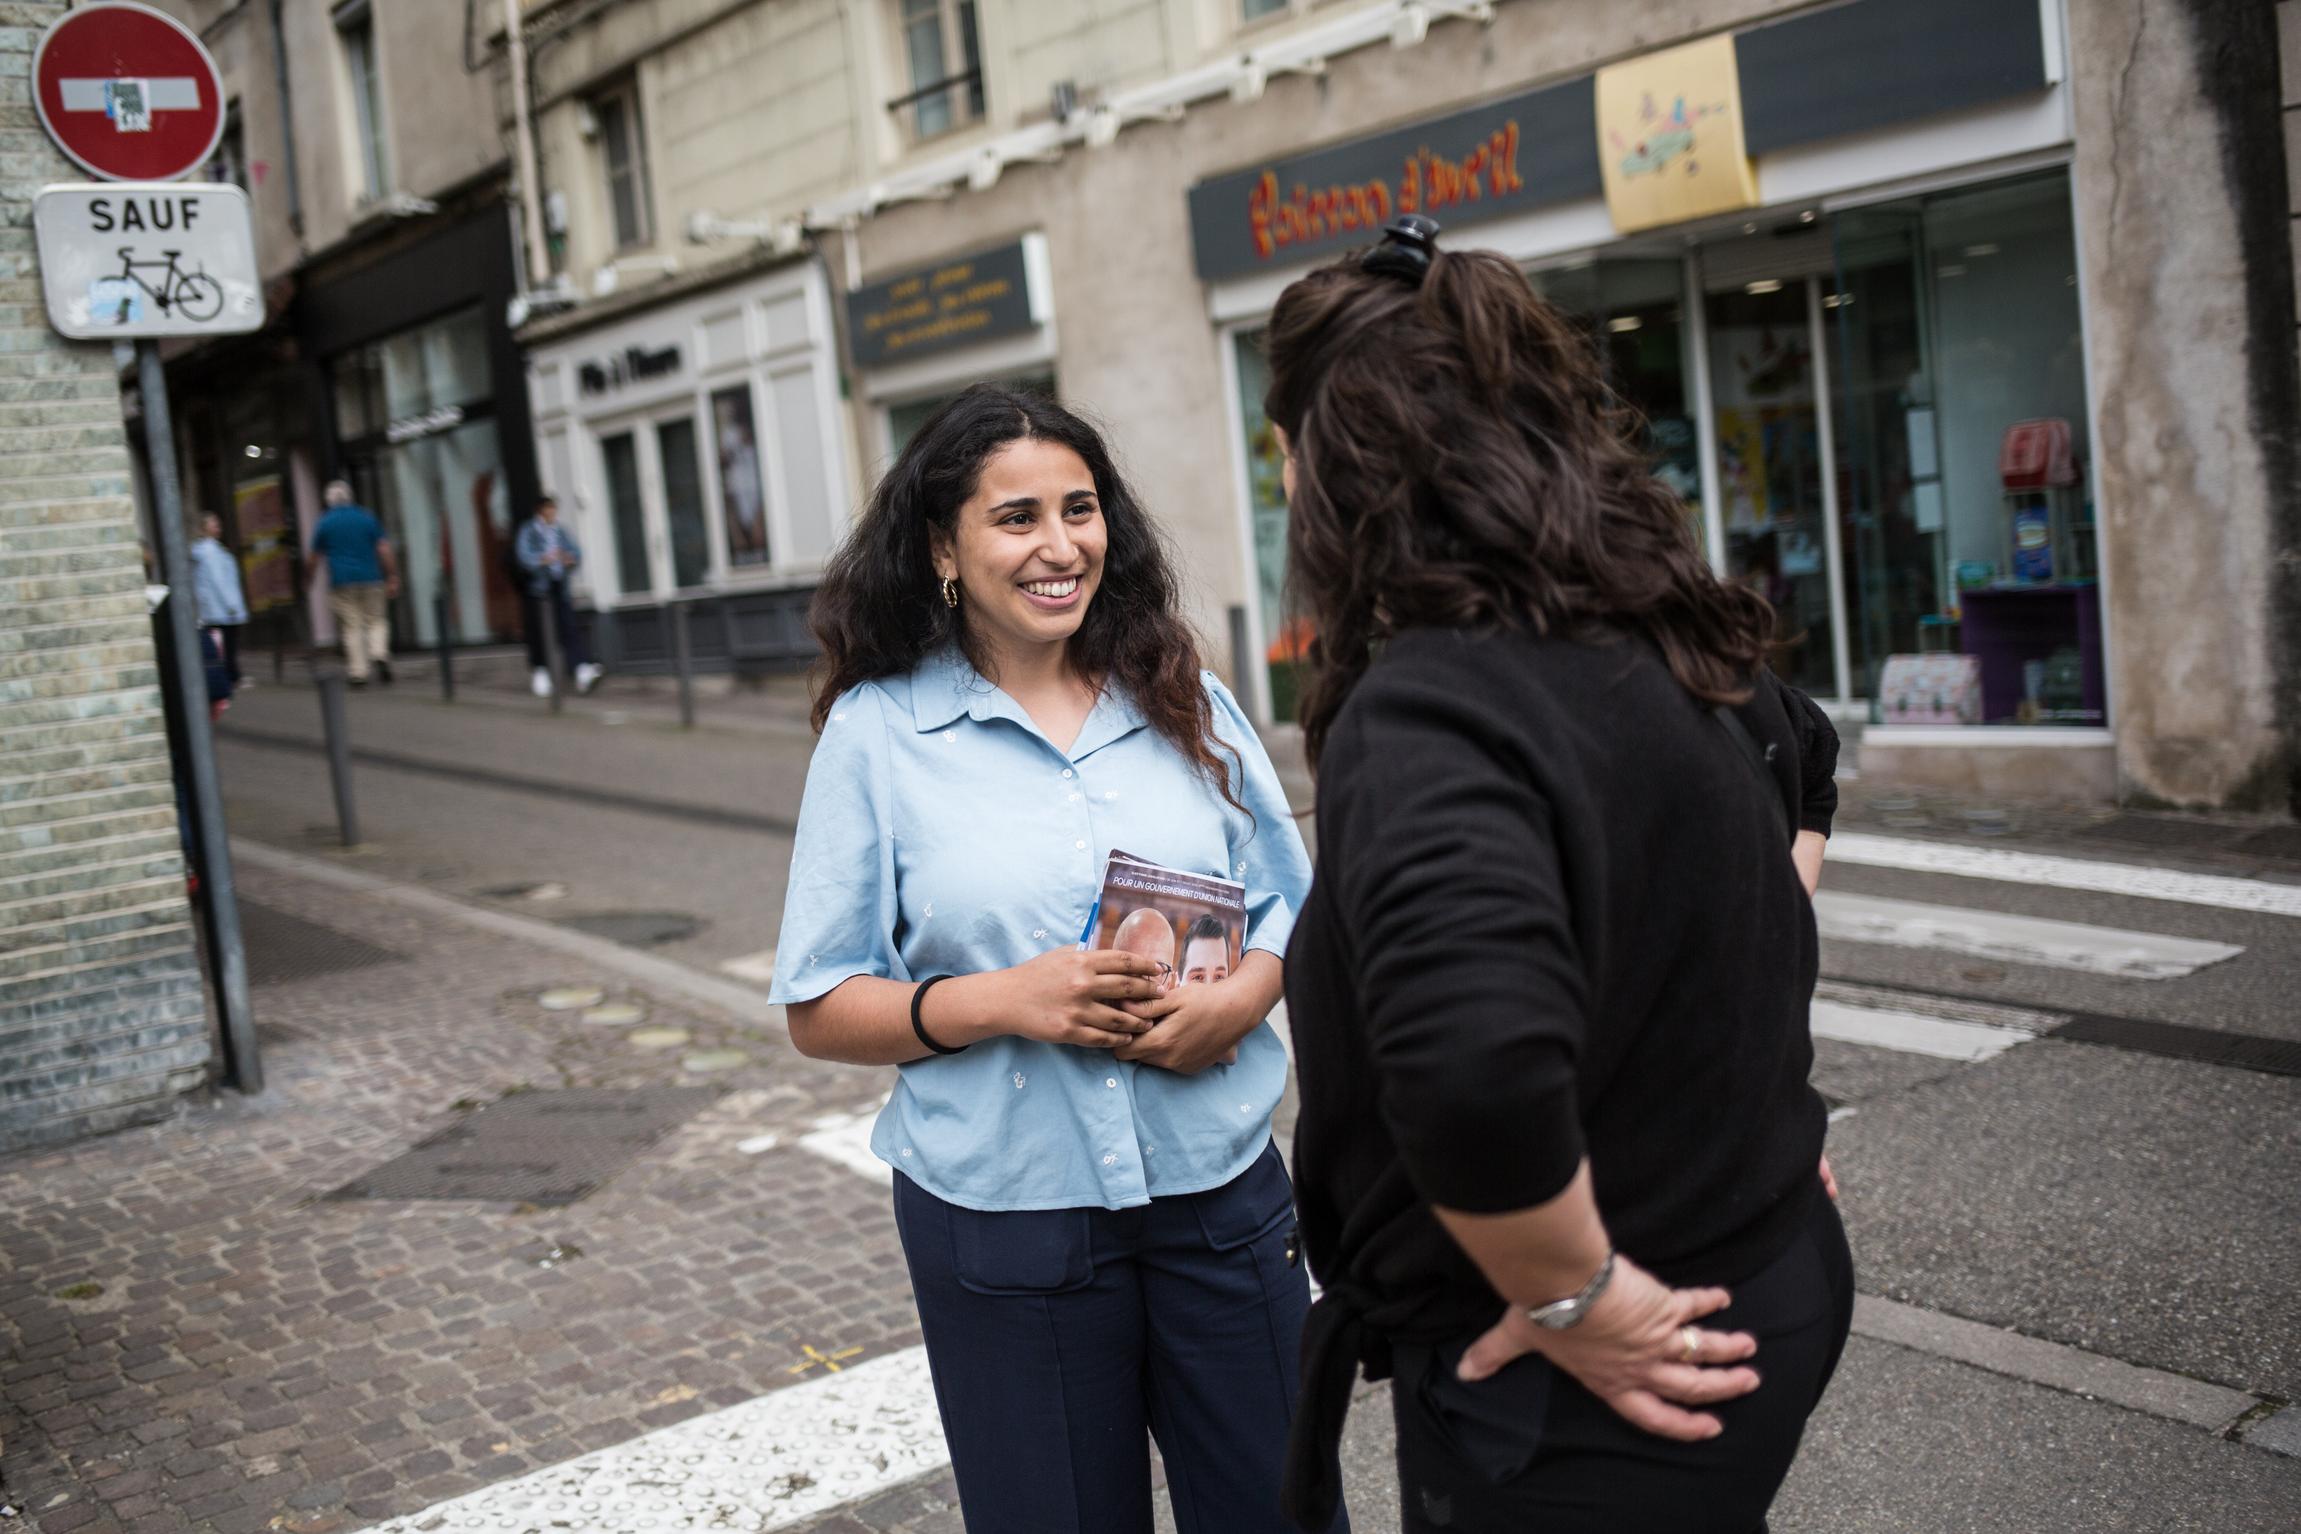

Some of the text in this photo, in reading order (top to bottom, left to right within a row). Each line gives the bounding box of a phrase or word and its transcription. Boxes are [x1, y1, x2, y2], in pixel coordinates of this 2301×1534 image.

[89, 198, 200, 231] SAUF
[1113, 876, 1134, 887] POUR
[1134, 880, 1145, 889] UN
[1145, 882, 1193, 899] GOUVERNEMENT
[1193, 890, 1215, 902] D'UNION
[1215, 896, 1240, 909] NATIONALE
